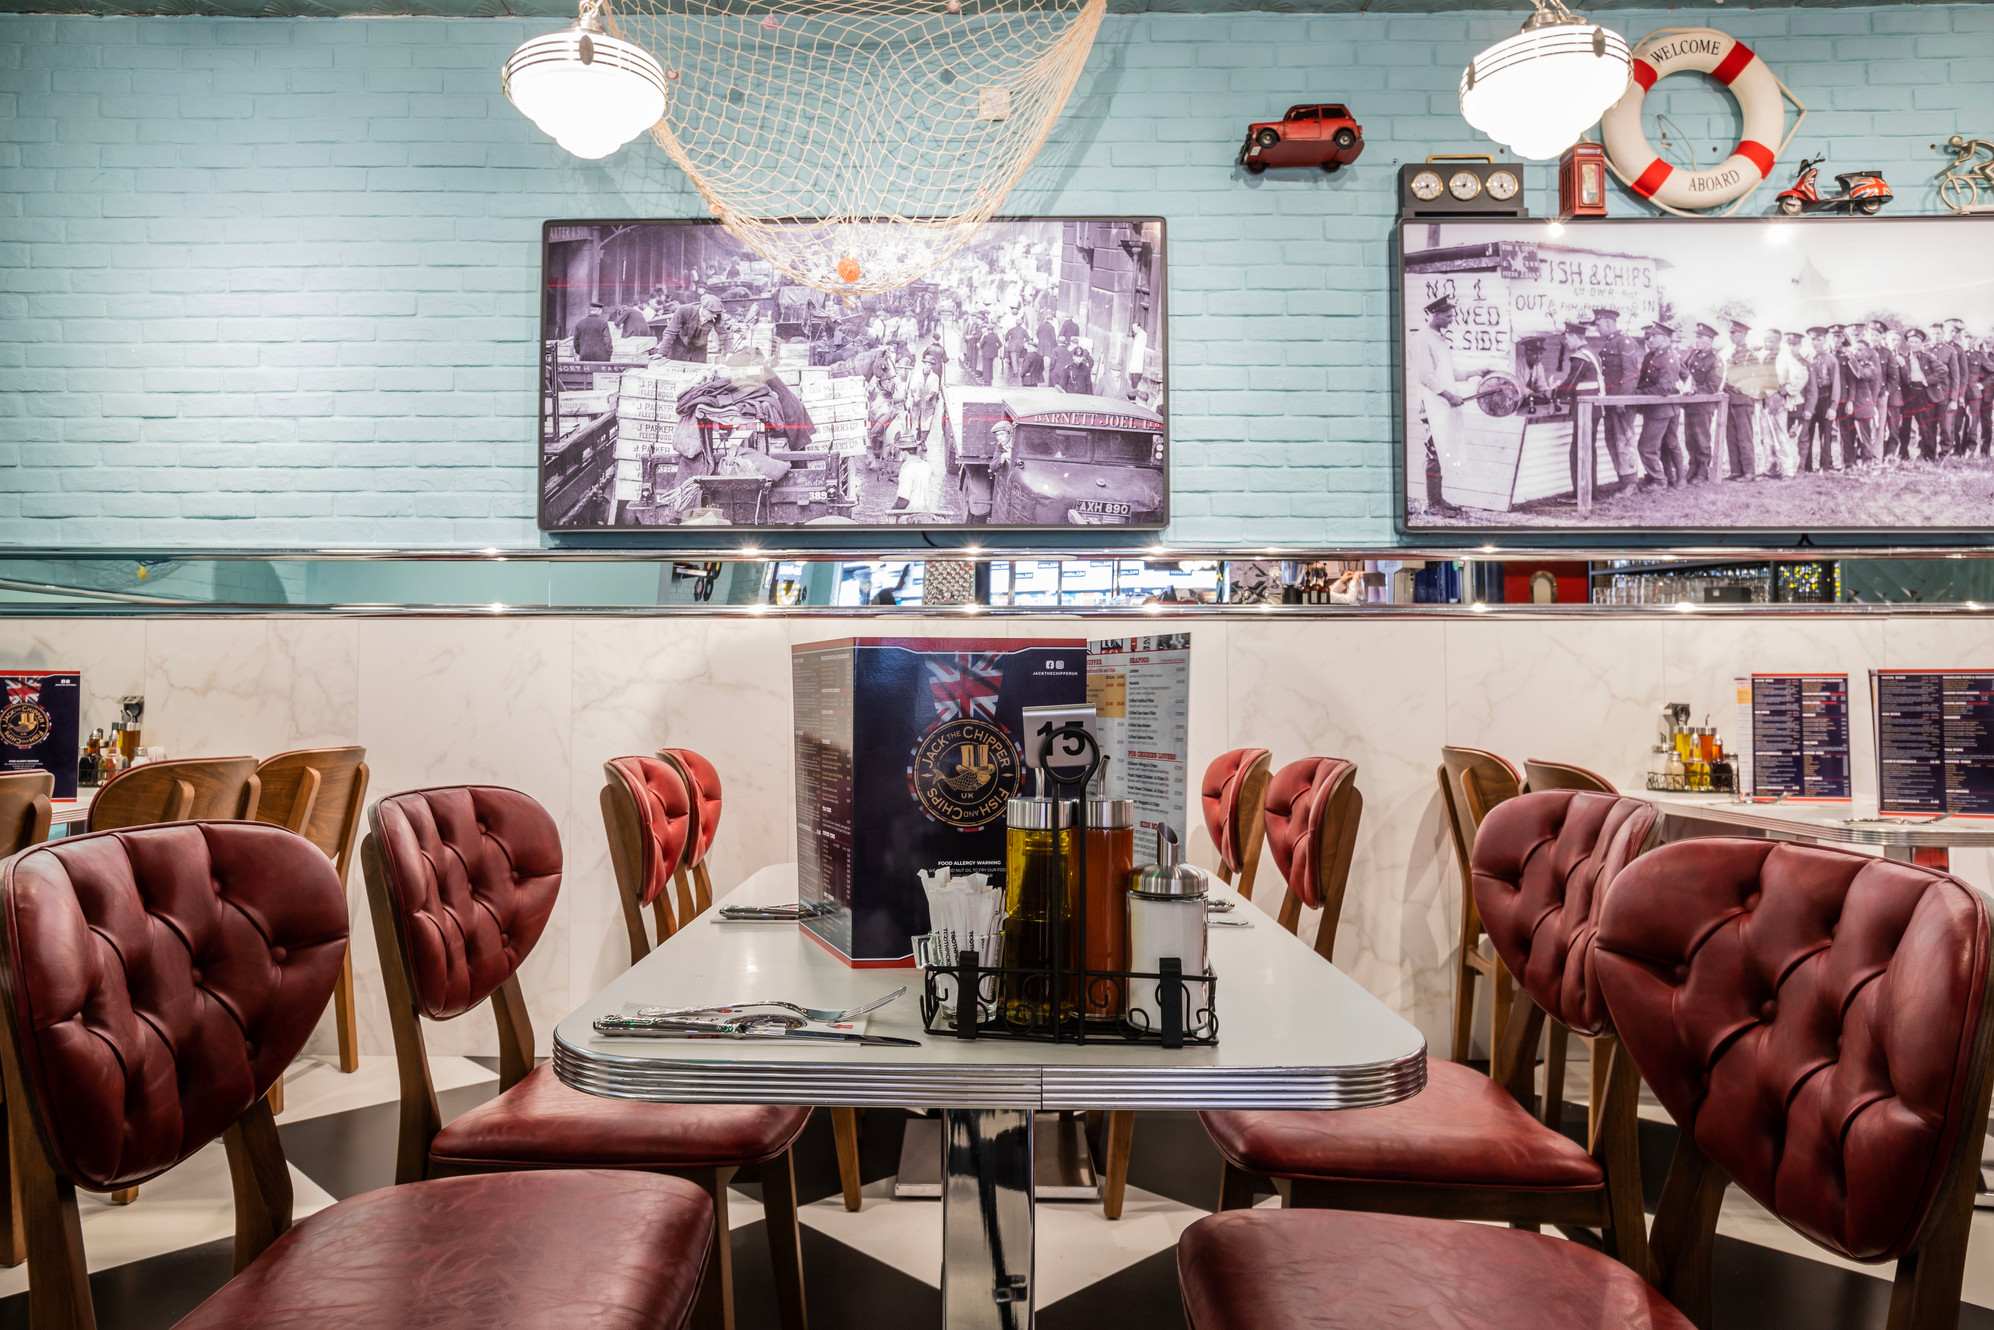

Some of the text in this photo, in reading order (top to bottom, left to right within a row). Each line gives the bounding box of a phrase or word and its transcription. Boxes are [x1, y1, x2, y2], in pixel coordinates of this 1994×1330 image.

[1650, 39, 1721, 64] WELCOME
[1688, 169, 1740, 192] ABOARD
[1539, 259, 1583, 285] ISH
[1515, 294, 1547, 311] OUT
[1463, 330, 1508, 351] SIDE
[648, 381, 676, 391] PAKER
[641, 391, 674, 399] FLEEWOOD
[645, 403, 674, 413] PAKER
[1034, 412, 1098, 426] BARNETT
[1100, 415, 1137, 429] JOEL
[639, 433, 672, 441] FLEETOOD
[642, 445, 671, 453] PAKER
[808, 491, 828, 500] 389
[1079, 501, 1128, 514] AXH 890
[922, 726, 1011, 768] JACK THE CHIPPER
[1036, 721, 1086, 756] 15
[927, 788, 1010, 820] FISH AND CHIPS
